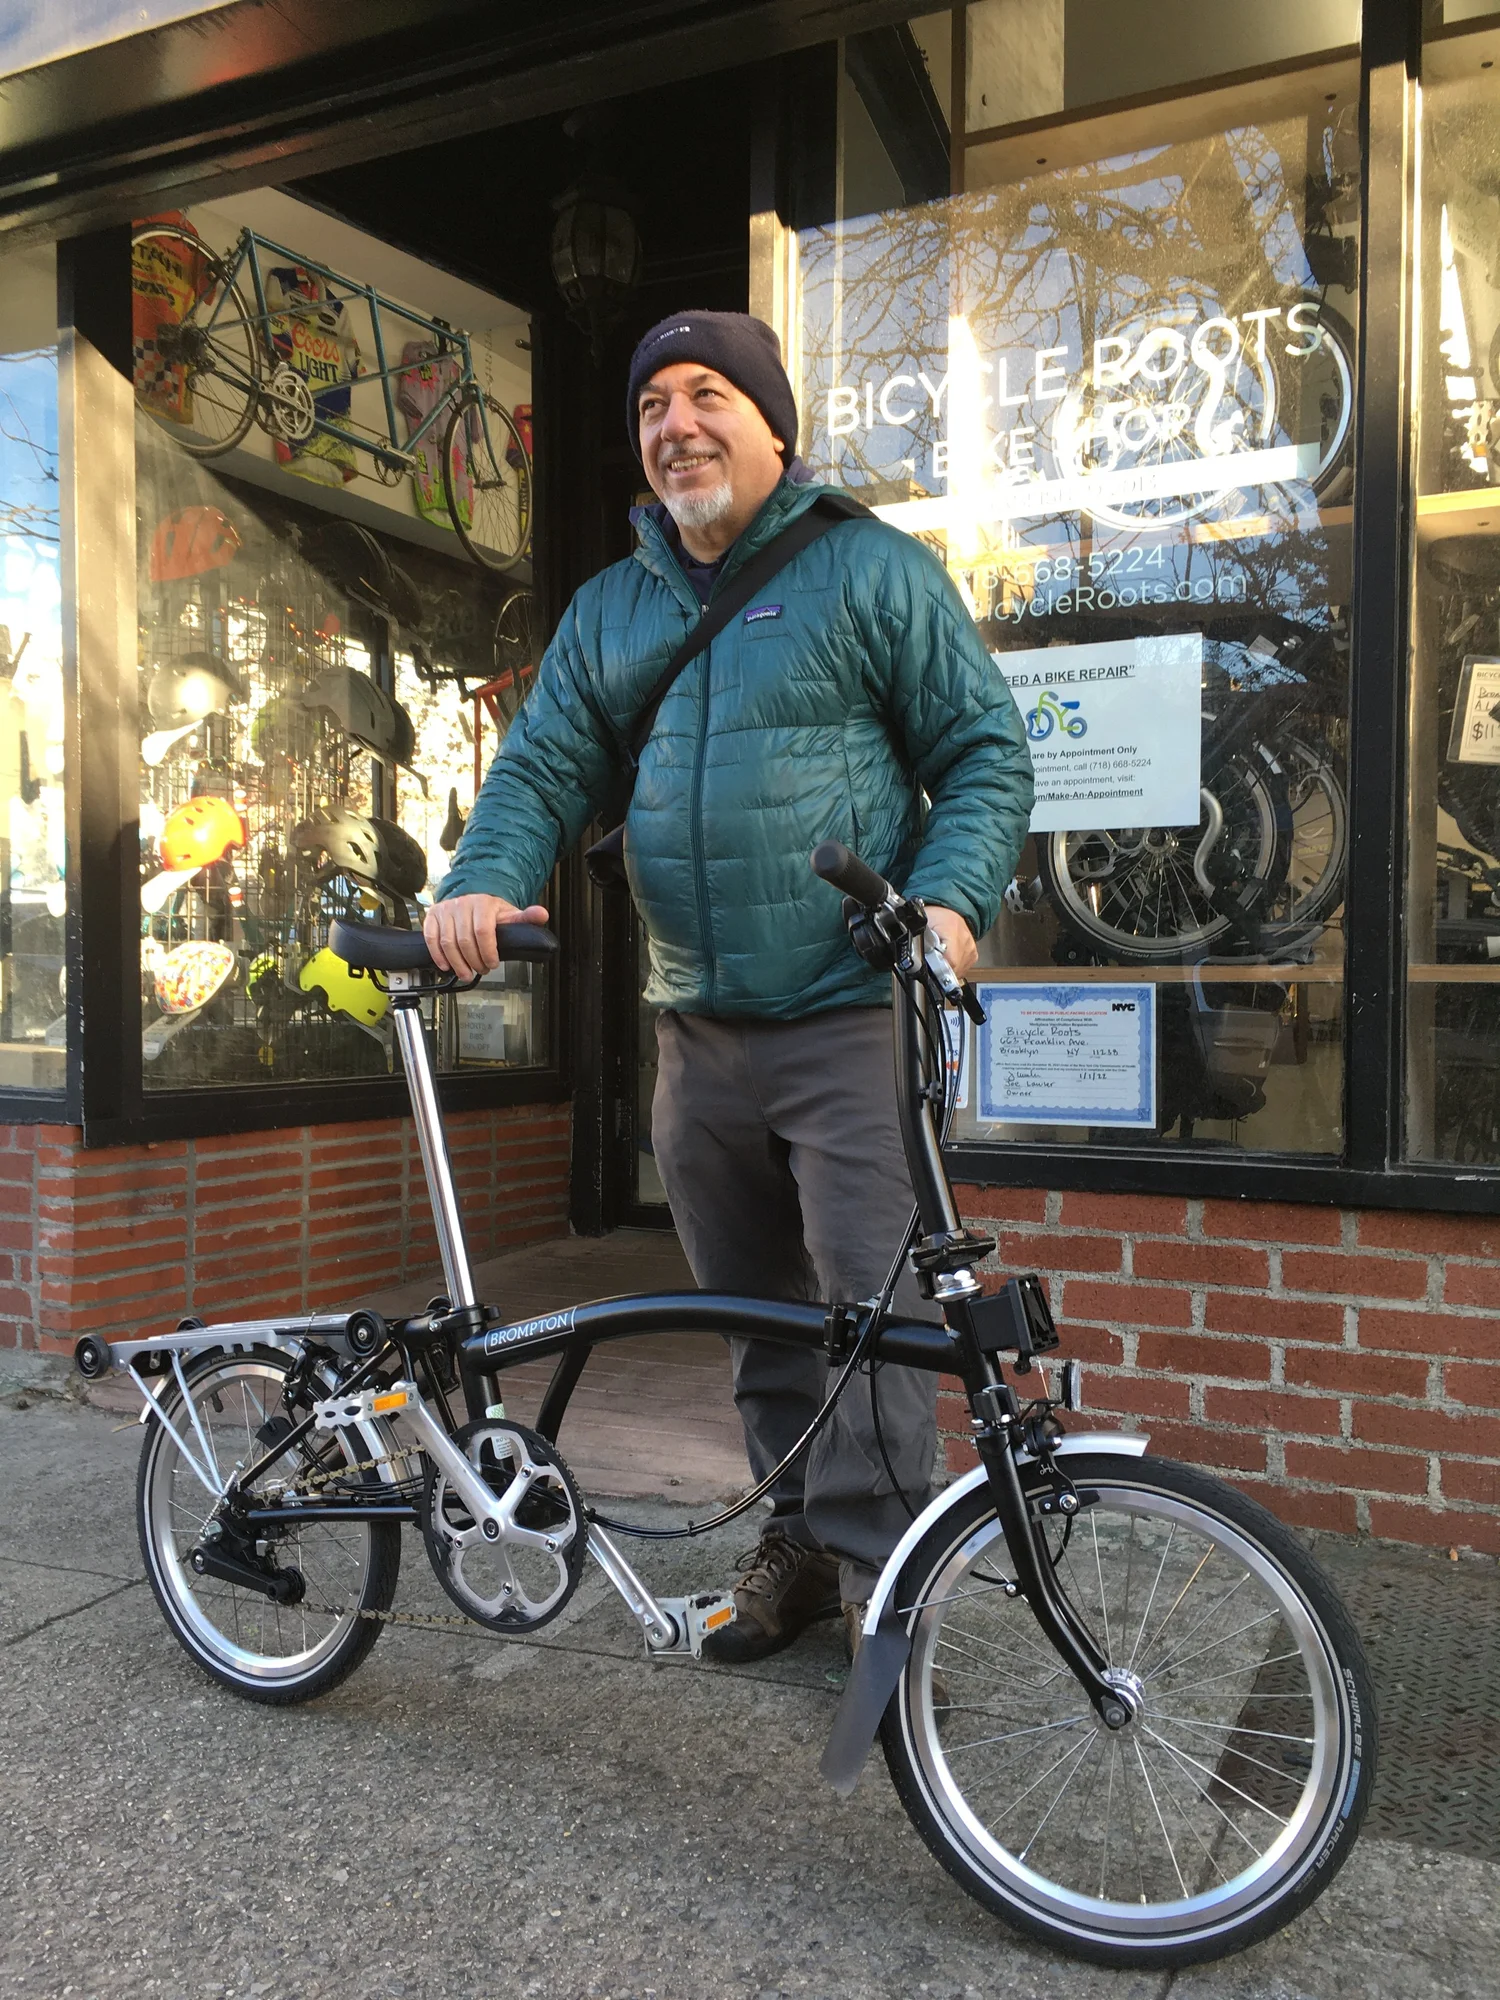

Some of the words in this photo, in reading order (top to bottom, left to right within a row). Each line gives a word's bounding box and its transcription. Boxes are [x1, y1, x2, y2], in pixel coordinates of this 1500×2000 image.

[291, 321, 341, 363] Coors
[299, 351, 339, 383] LIGHT
[827, 345, 1068, 437] BICYLE
[1093, 302, 1323, 391] ROOTS
[932, 425, 1035, 479] BKE
[1004, 674, 1028, 687] EED
[1032, 673, 1041, 684] A
[1045, 670, 1076, 683] BIKE
[1031, 752, 1045, 760] are
[1047, 750, 1058, 760] by
[1060, 747, 1115, 759] Appointment
[1117, 745, 1137, 756] Only
[1034, 764, 1071, 774] ointment,
[1074, 763, 1087, 771] call
[1089, 761, 1111, 771] (718)
[1113, 758, 1151, 769] 668-5224
[1034, 780, 1049, 788] ave
[1051, 779, 1061, 787] an
[1063, 775, 1115, 787] appointment,
[1117, 774, 1136, 783] visit:
[1112, 1003, 1135, 1012] NYC
[1006, 1027, 1045, 1041] Bicycle
[1051, 1027, 1082, 1037] Roots
[1023, 1037, 1066, 1046] Franklin
[999, 1047, 1039, 1058] Brooklyn
[1067, 1048, 1080, 1056] NY
[489, 1312, 569, 1347] BROMPTON
[1342, 1667, 1363, 1758] SCHWALBE
[1315, 1818, 1345, 1870] RACER
